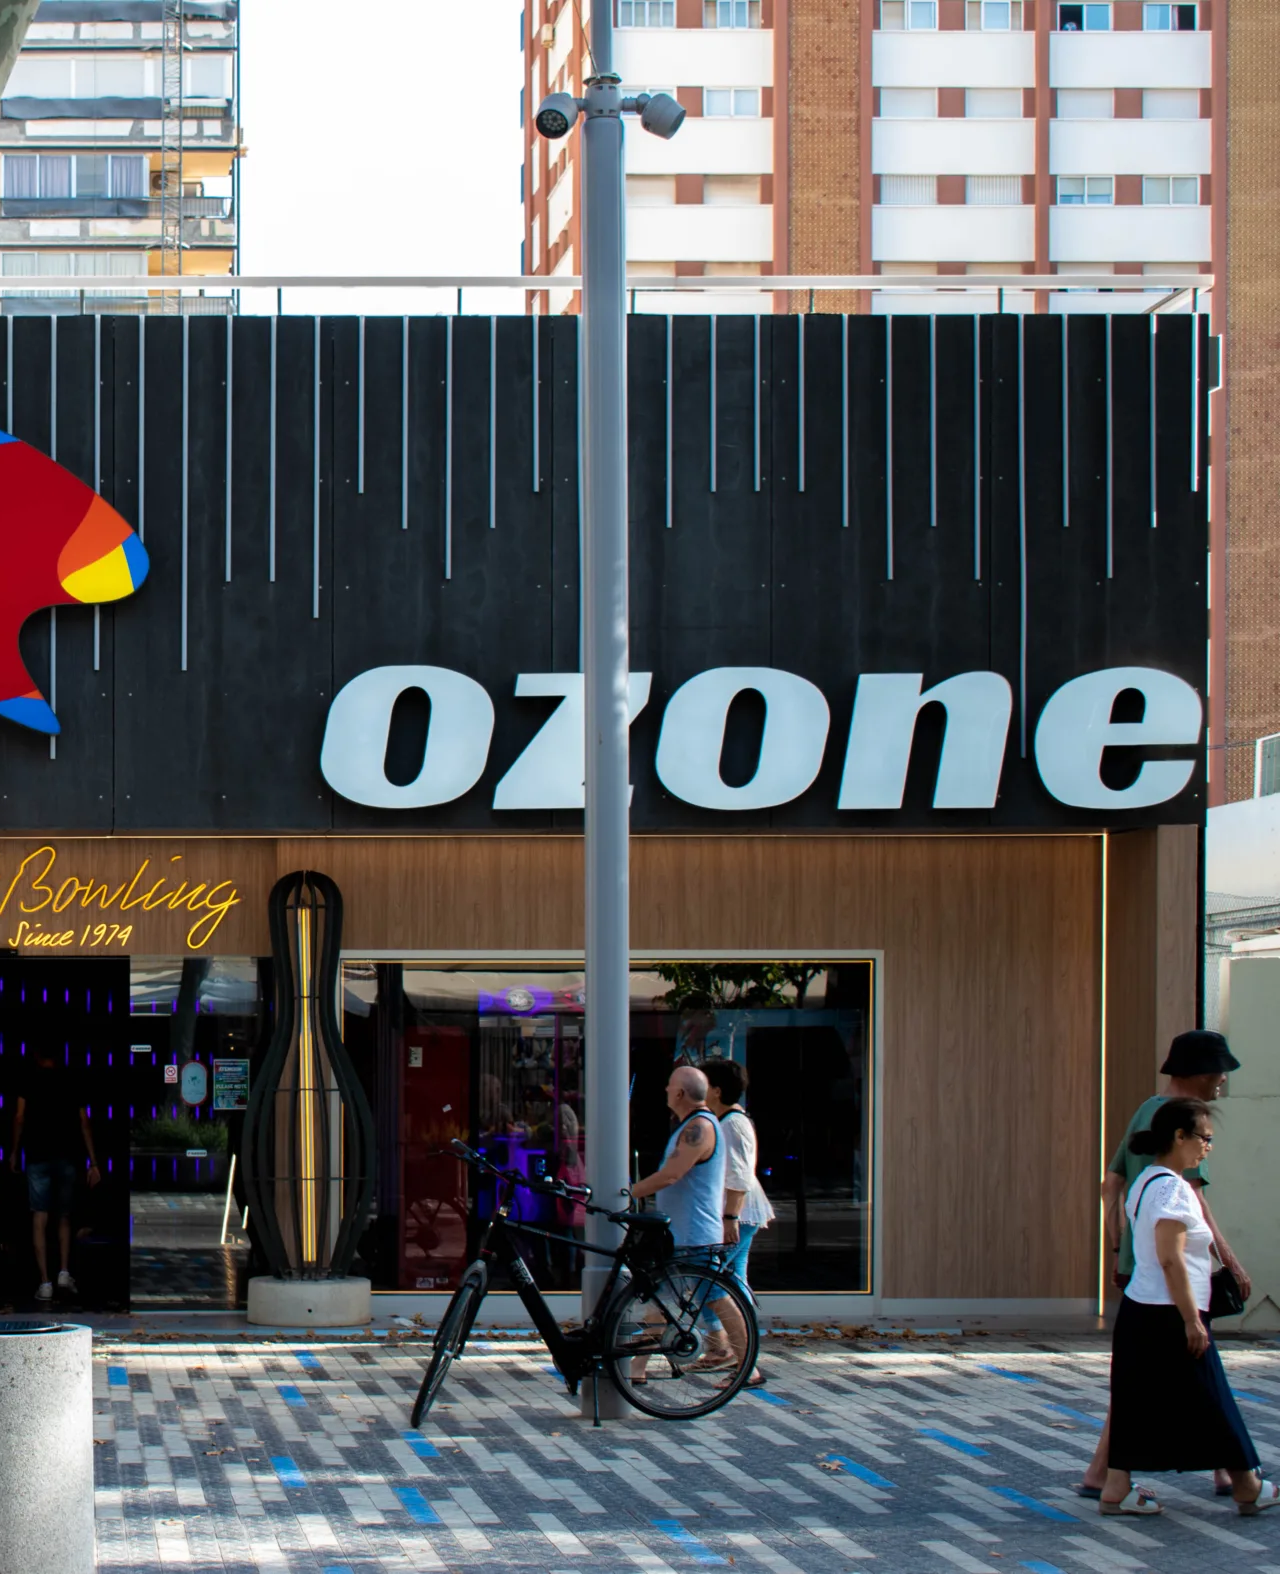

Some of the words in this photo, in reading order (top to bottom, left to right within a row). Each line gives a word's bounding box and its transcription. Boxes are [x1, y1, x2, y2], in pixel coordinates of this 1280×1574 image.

[320, 664, 1204, 811] ozone
[8, 920, 75, 947] Since
[79, 923, 133, 947] 1974
